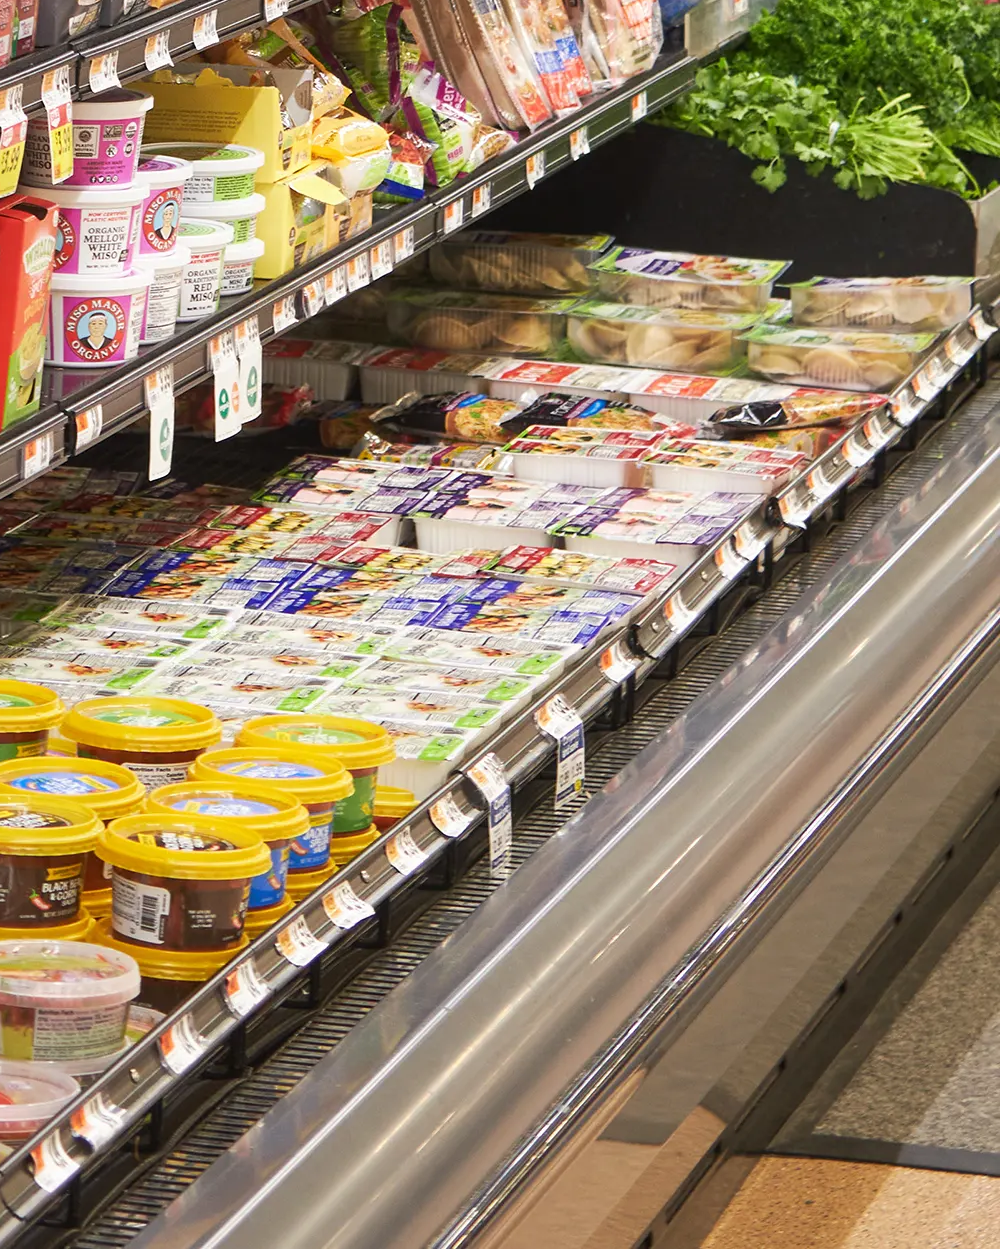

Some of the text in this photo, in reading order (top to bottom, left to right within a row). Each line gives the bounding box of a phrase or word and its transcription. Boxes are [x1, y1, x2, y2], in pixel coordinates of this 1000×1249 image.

[144, 194, 165, 225] MISO
[87, 226, 125, 235] ORGANIC
[83, 234, 127, 244] MELLOW
[88, 243, 123, 252] WHITE
[91, 250, 118, 261] MISO
[187, 268, 218, 277] ORGANIC
[193, 283, 213, 293] RED
[190, 291, 213, 303] MISO
[67, 303, 89, 334] MISO
[91, 299, 126, 332] MASTER
[71, 339, 120, 361] ORGANIC
[41, 881, 67, 894] BLACK
